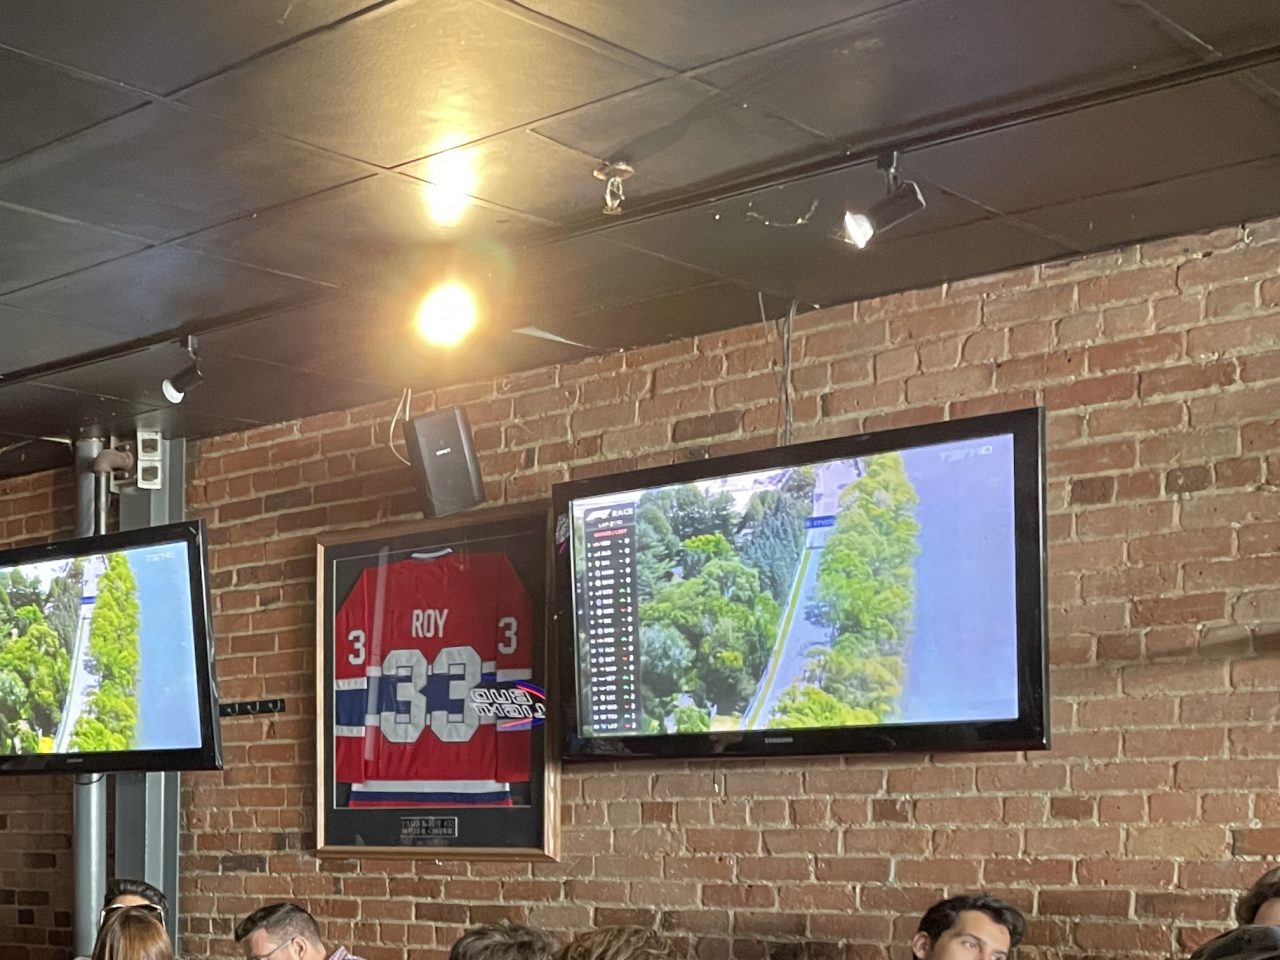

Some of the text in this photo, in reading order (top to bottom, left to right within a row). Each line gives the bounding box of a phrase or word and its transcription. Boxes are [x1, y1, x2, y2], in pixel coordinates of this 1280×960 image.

[412, 608, 449, 638] ROY
[498, 616, 518, 654] 3
[347, 629, 366, 665] 3
[380, 645, 482, 743] 33
